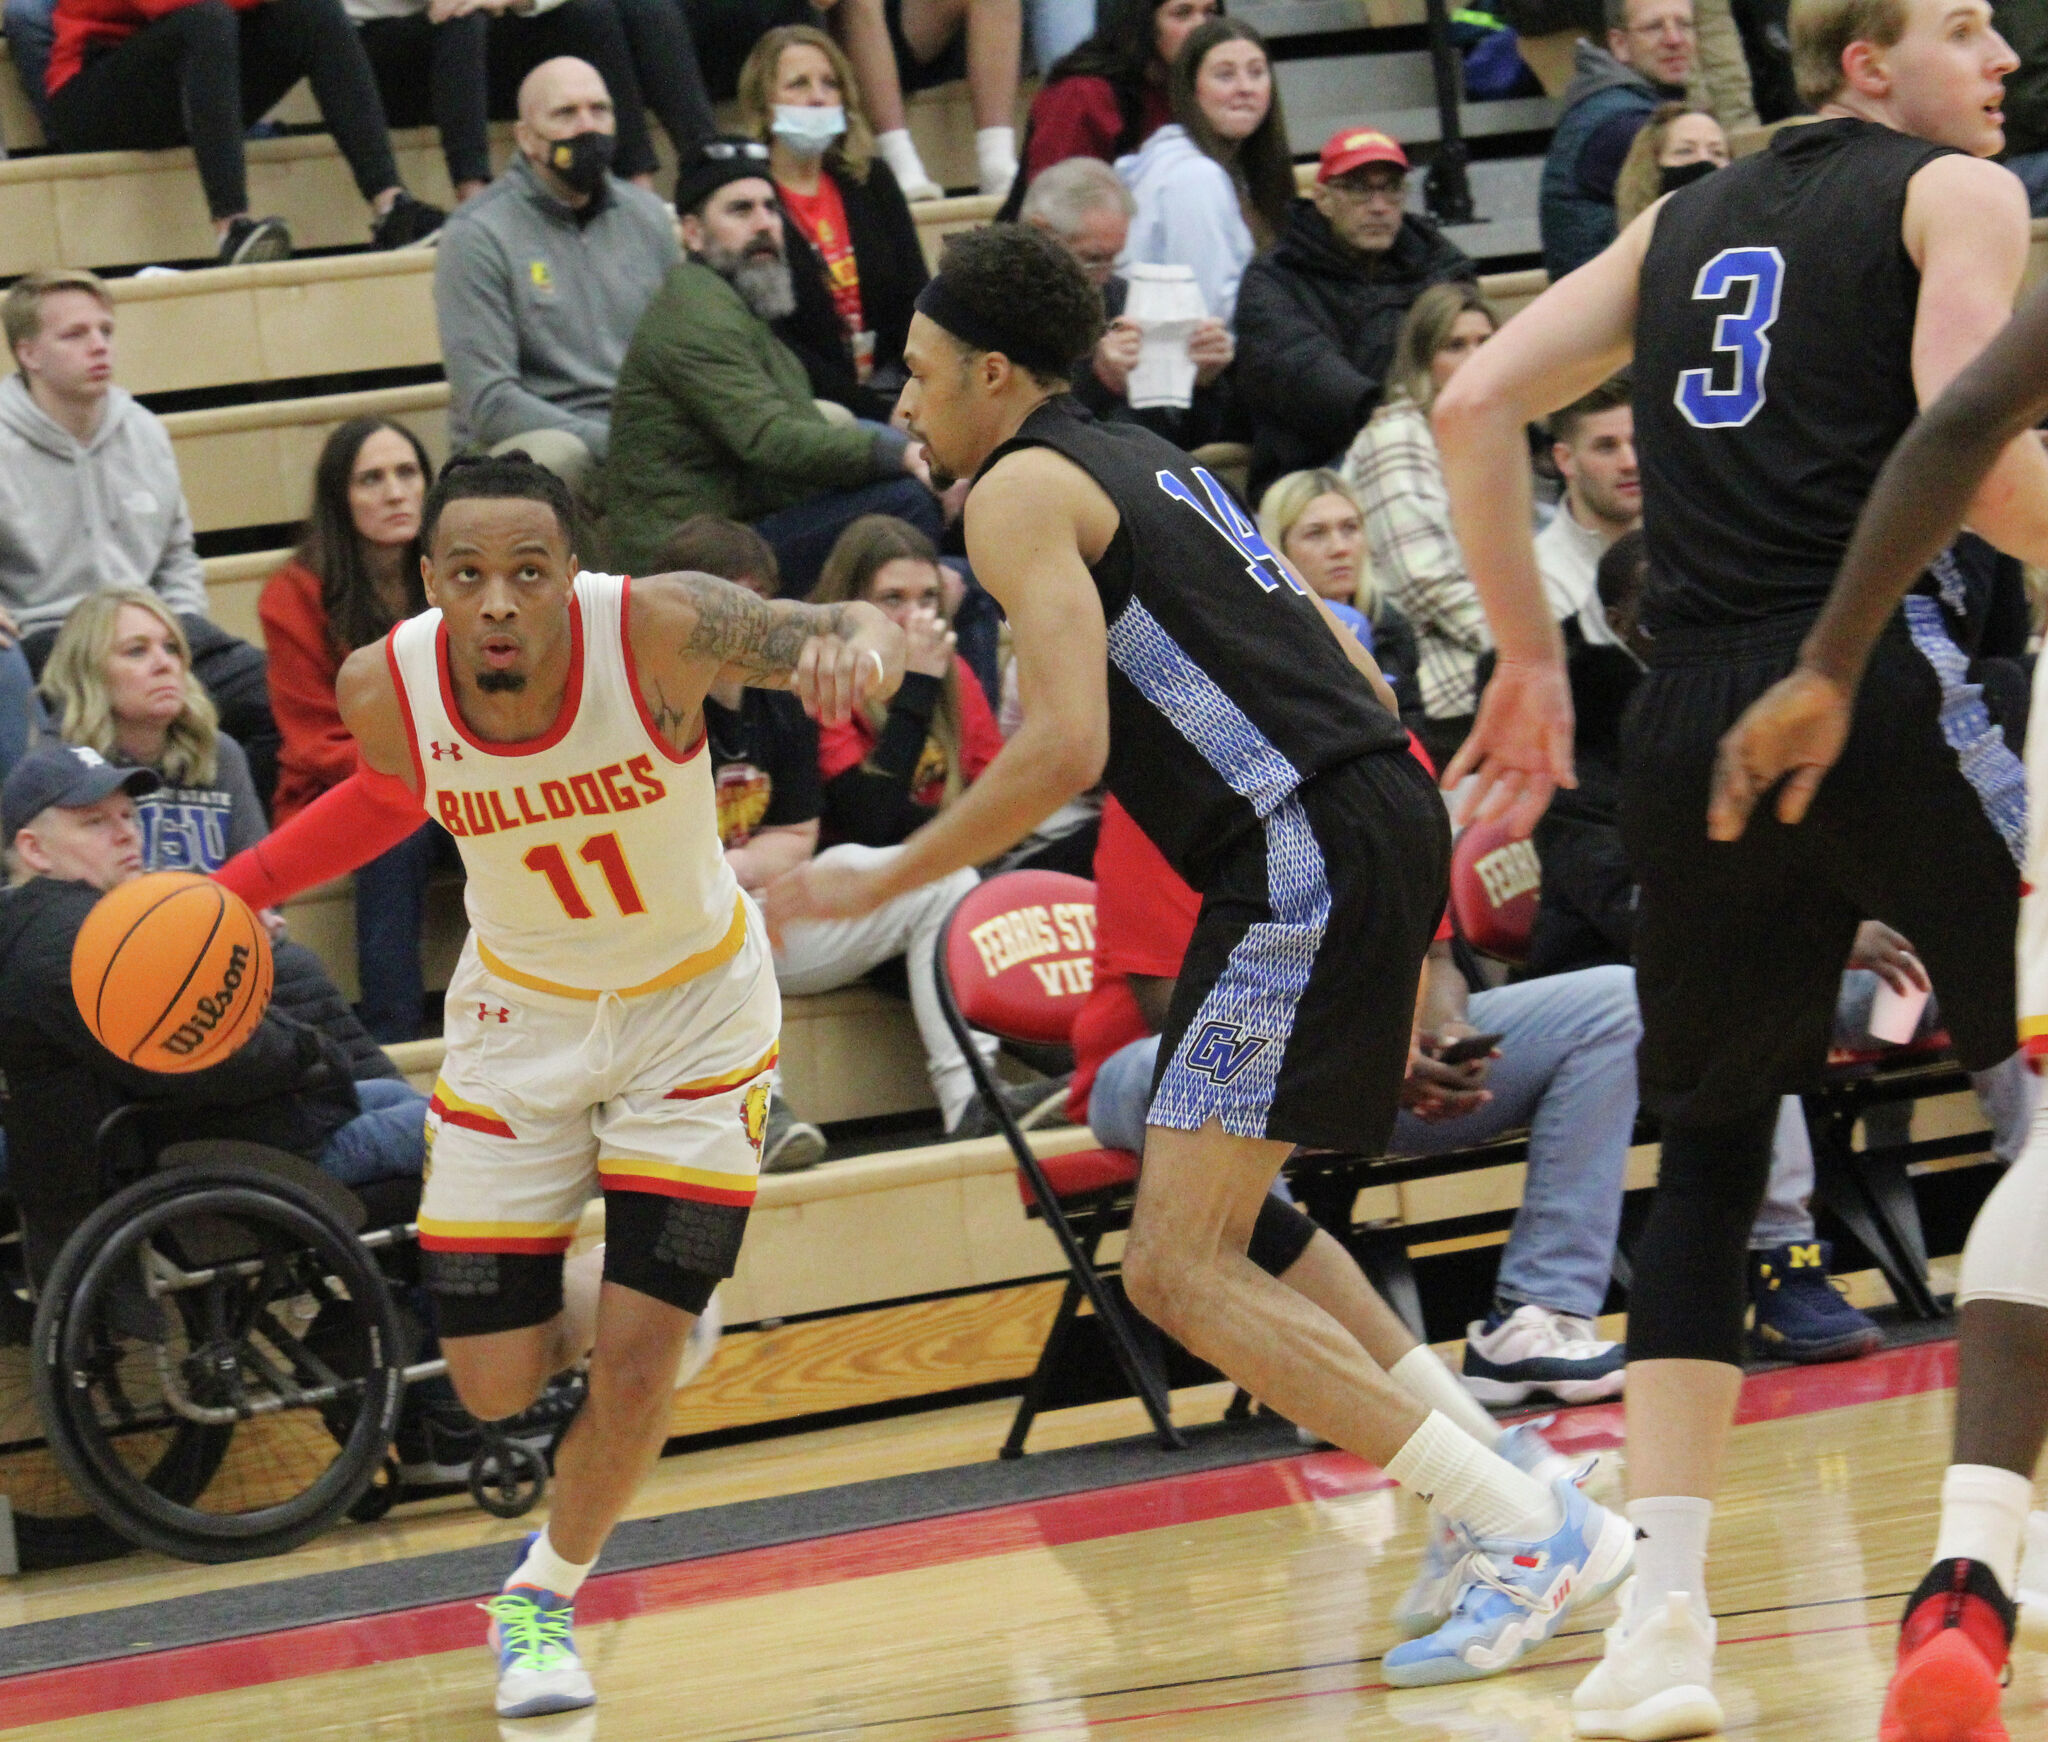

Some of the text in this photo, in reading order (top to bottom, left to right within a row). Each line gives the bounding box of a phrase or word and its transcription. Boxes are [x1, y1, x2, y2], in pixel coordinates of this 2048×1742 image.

[1673, 247, 1786, 429] 3
[1155, 466, 1307, 595] 14
[436, 752, 667, 837] BULLDOGS
[521, 829, 649, 920] 11
[969, 905, 1061, 978] FERRIS
[161, 944, 250, 1055] Wilson
[1185, 1020, 1271, 1088] GV
[1788, 1244, 1822, 1269] M
